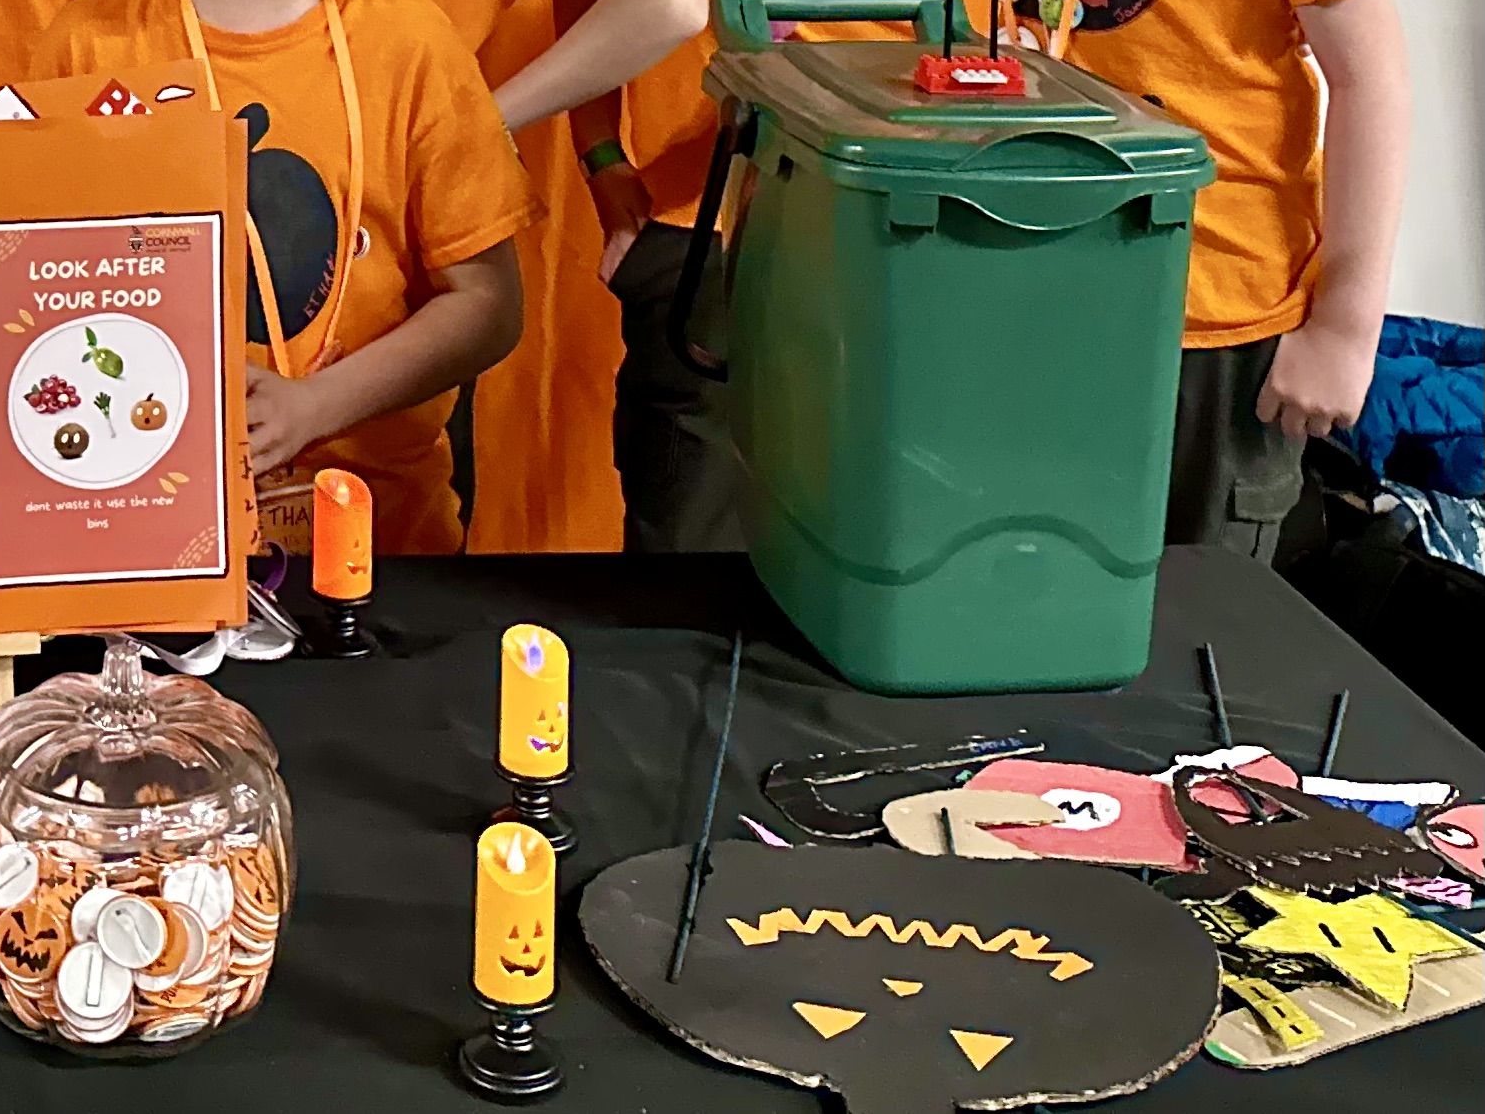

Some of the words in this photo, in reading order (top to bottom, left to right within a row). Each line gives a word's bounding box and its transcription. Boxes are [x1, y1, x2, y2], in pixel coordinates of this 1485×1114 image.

[145, 236, 192, 247] COUNCIL
[29, 260, 90, 281] LOOK
[95, 256, 165, 278] AFTER
[33, 291, 96, 312] YOUR
[101, 288, 162, 309] FOOD
[25, 500, 51, 512] dont
[55, 498, 90, 511] waste
[93, 498, 103, 510] it
[107, 498, 127, 509] use
[130, 495, 149, 508] the
[152, 495, 175, 507] new
[86, 518, 110, 530] bins
